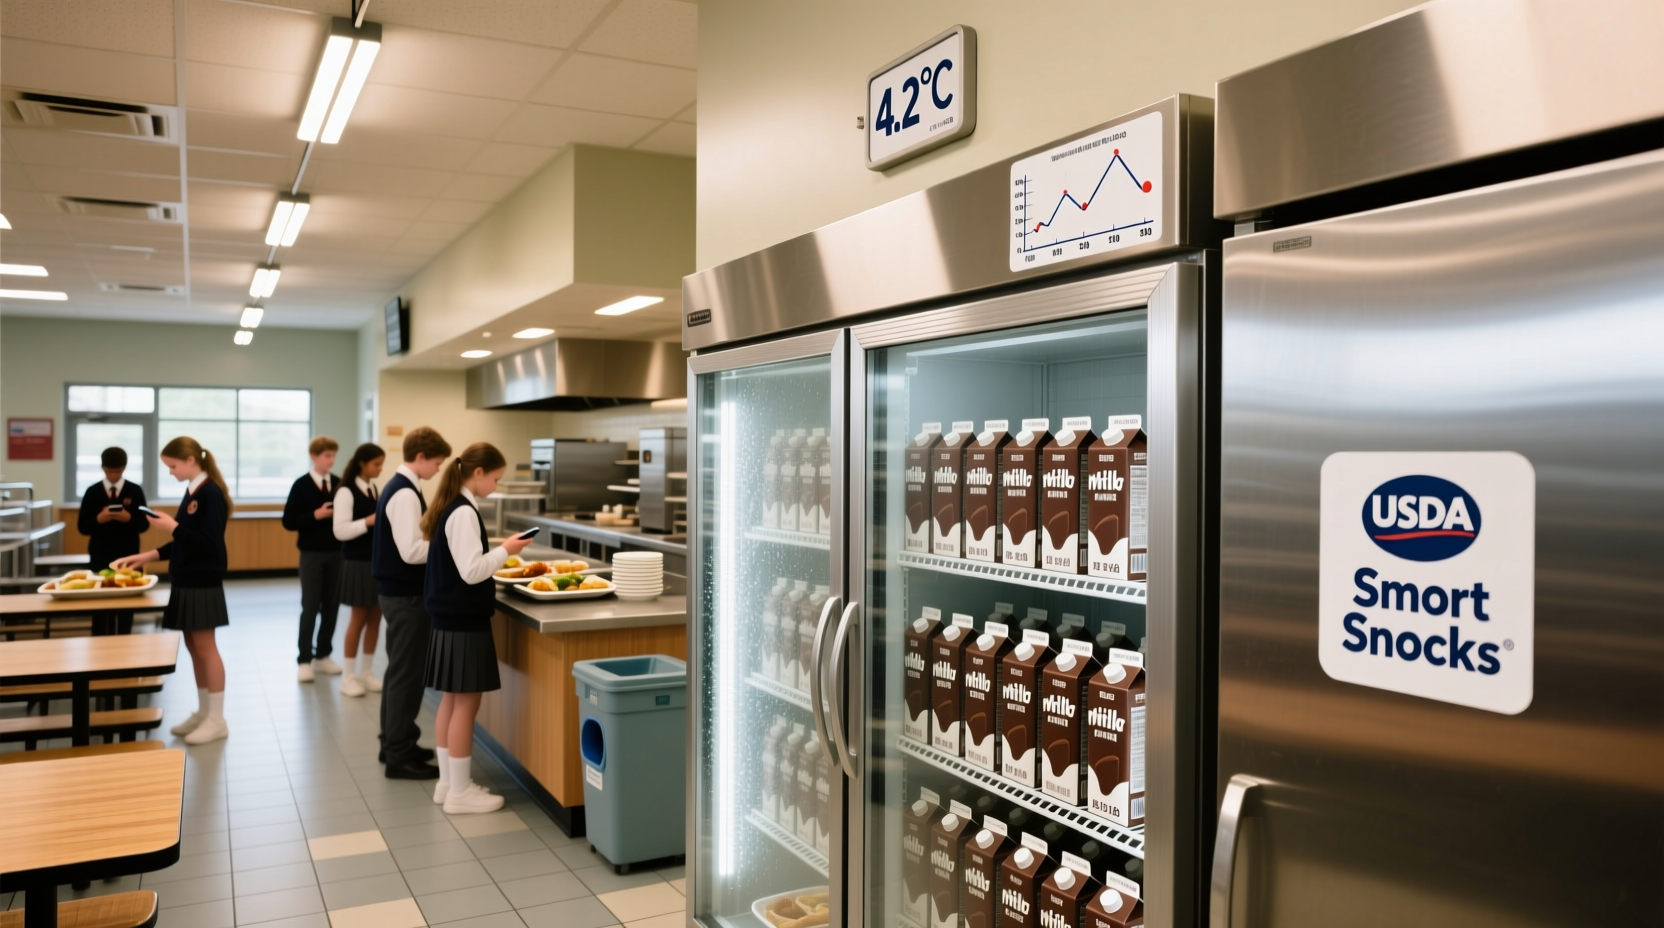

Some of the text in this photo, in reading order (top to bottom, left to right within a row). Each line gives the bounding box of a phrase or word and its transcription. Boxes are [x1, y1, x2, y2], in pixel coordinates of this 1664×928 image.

[875, 58, 954, 137] 4.2°C
[1371, 494, 1475, 531] USDA
[1353, 567, 1490, 622] Smort
[1342, 612, 1501, 675] Snocks
